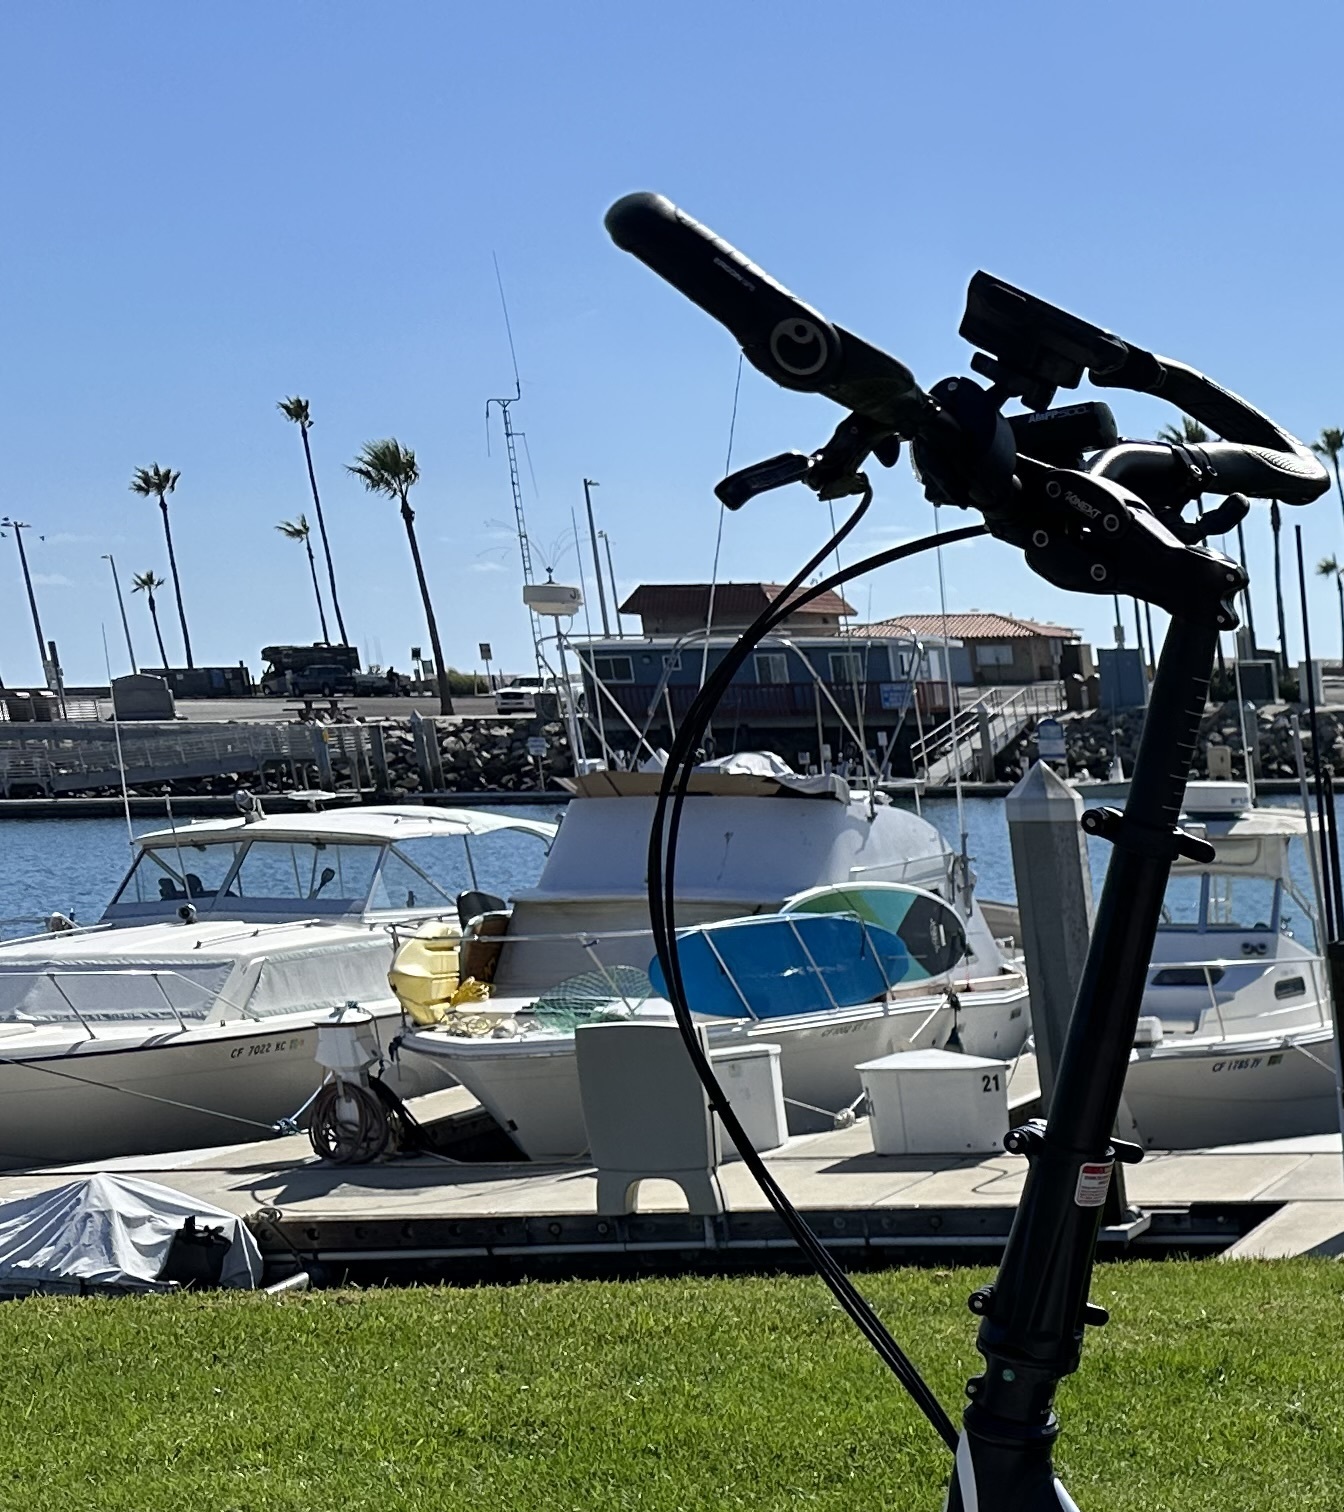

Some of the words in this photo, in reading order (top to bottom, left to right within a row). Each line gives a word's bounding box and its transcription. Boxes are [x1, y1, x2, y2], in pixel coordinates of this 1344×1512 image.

[230, 1047, 244, 1059] CF
[248, 1042, 271, 1057] 7022
[1212, 1061, 1226, 1073] CF
[982, 1074, 1000, 1092] 21
